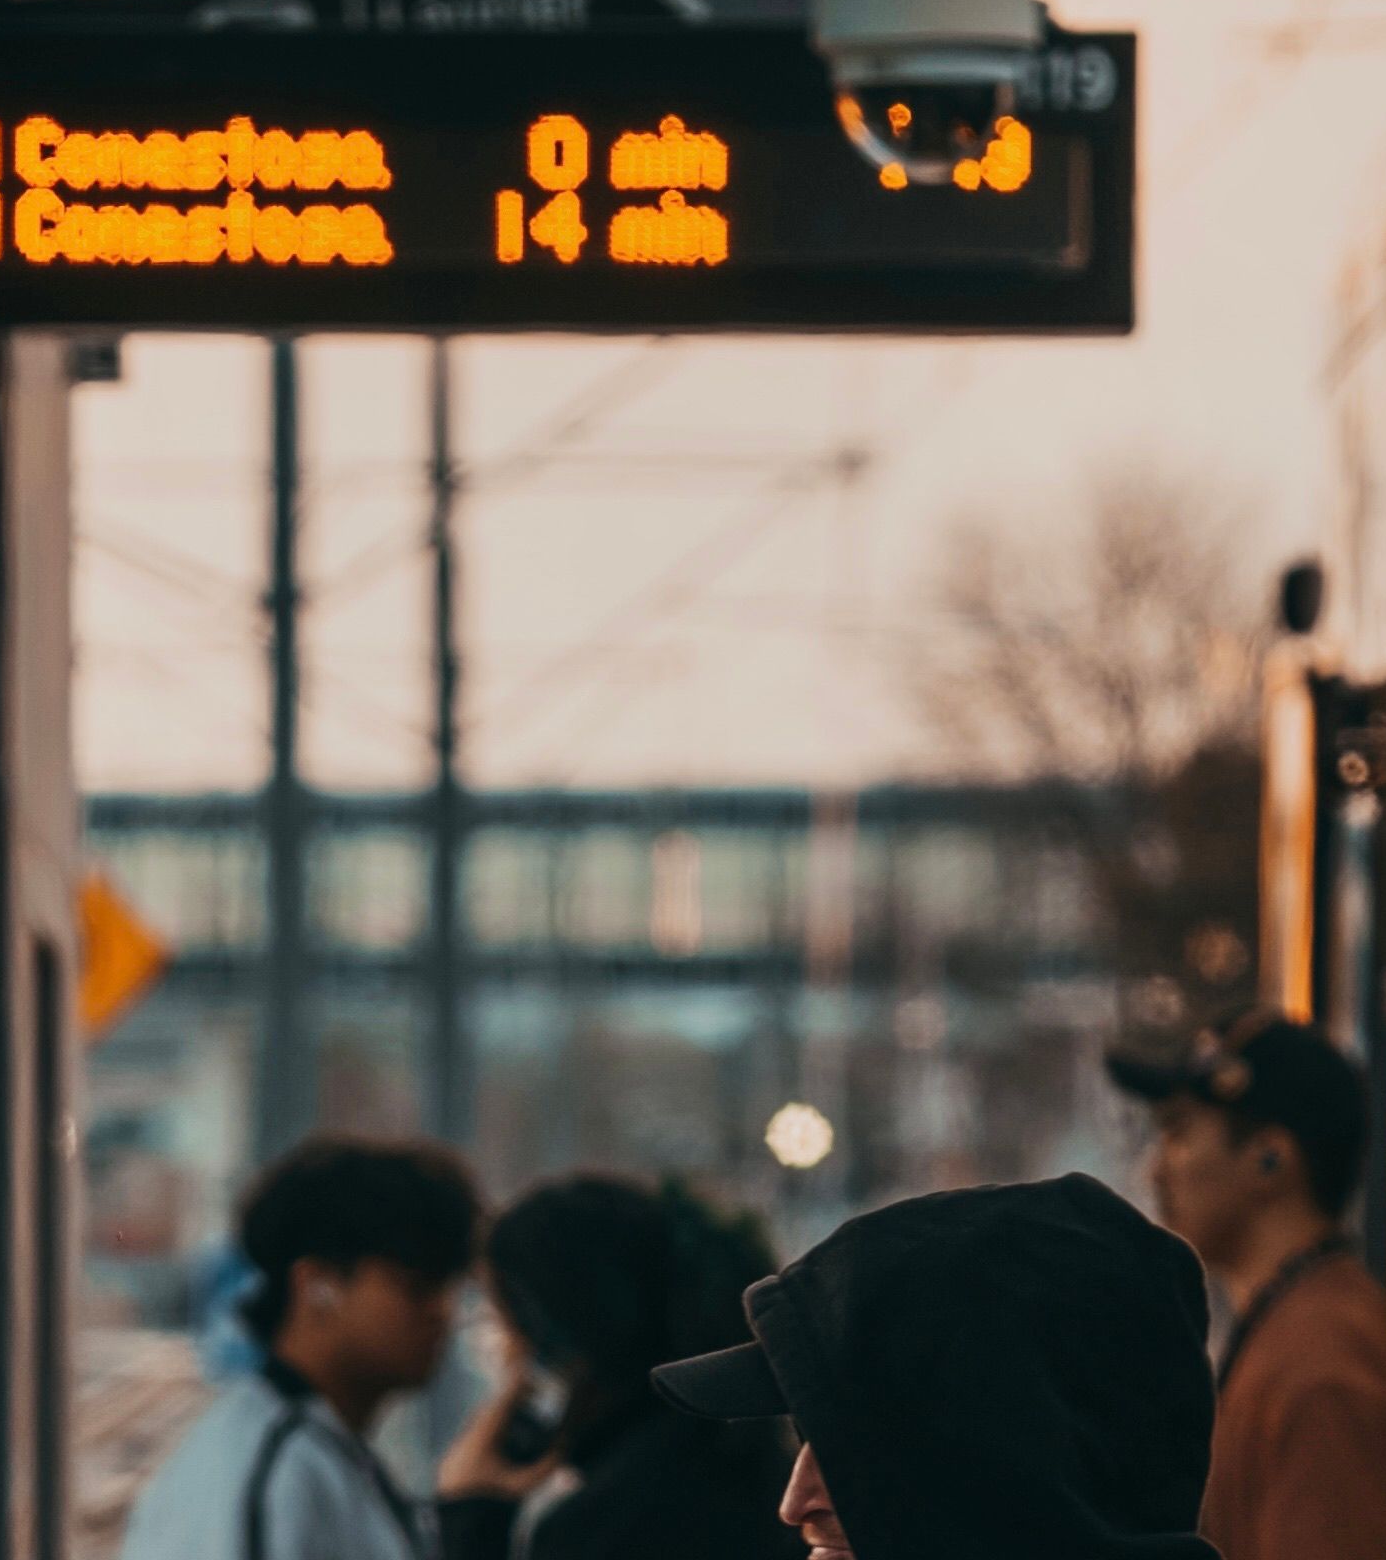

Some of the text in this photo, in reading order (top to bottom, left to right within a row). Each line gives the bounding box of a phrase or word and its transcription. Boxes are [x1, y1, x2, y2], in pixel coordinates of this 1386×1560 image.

[526, 114, 591, 192] 0
[610, 114, 729, 191] min
[495, 188, 589, 265] 14
[610, 188, 729, 266] min
